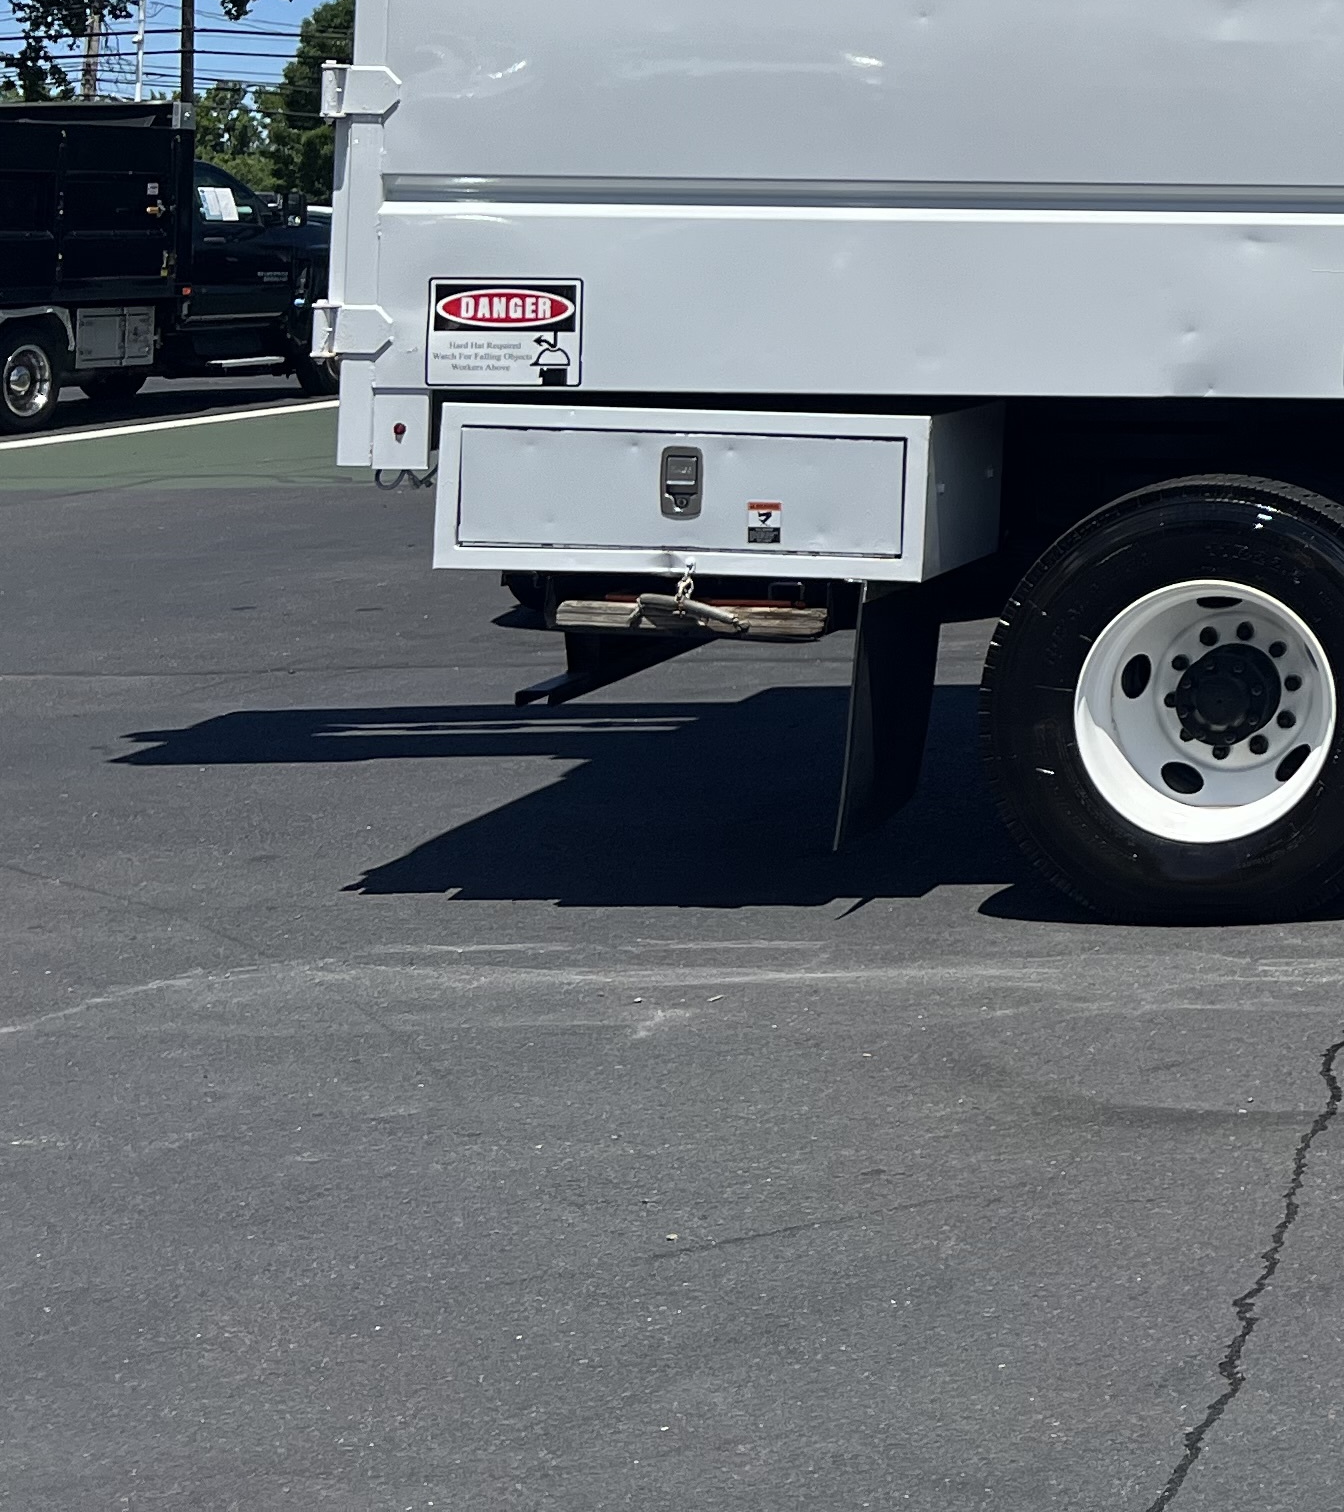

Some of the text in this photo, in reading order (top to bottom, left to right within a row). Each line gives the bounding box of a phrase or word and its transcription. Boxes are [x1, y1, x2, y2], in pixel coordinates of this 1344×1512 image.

[460, 296, 552, 320] DANGER
[449, 341, 522, 351] Hard Hat Required
[433, 352, 533, 363] Watch For Falling Objects
[451, 363, 511, 372] Workers Above
